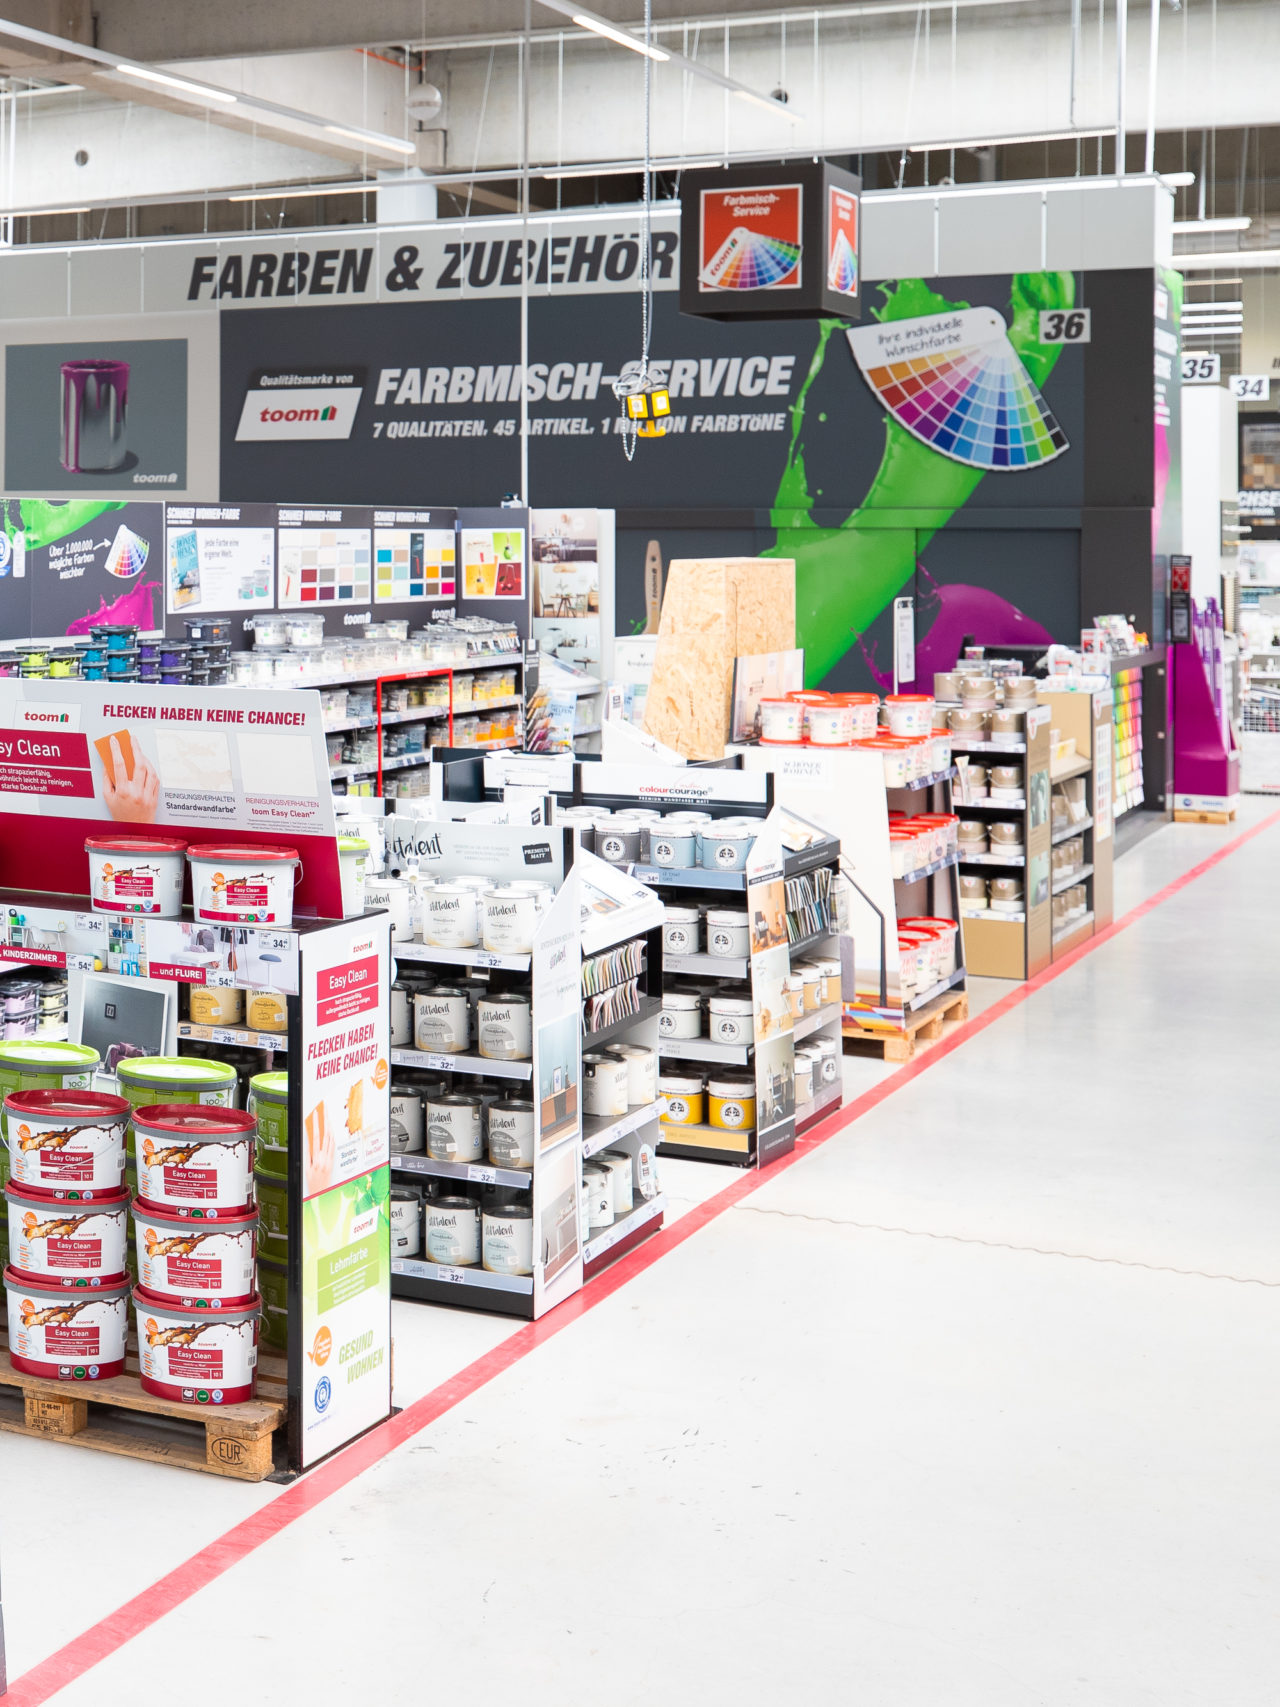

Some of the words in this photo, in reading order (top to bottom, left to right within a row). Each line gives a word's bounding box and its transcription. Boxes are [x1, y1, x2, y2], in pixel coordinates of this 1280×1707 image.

[723, 193, 779, 207] Farbmisch-
[733, 204, 770, 218] Service
[187, 247, 374, 300] FARBEN
[385, 245, 423, 292] &
[436, 231, 679, 290] ZUBEHÖR
[1043, 312, 1086, 341] 36
[1182, 359, 1215, 379] 35
[260, 374, 332, 387] Qualitätsmarke
[335, 375, 354, 385] von
[1237, 379, 1264, 397] 34
[259, 407, 322, 423] toom
[373, 423, 384, 438] 7
[494, 419, 516, 436] 45
[601, 418, 611, 434] 1
[690, 413, 786, 432] FARBTÖNE
[133, 473, 168, 484] toom
[344, 613, 365, 626] toom
[24, 711, 59, 722] toom
[103, 704, 157, 720] FLECKEN
[160, 707, 203, 722] HABEN
[206, 709, 245, 723] KEINE
[248, 711, 306, 726] CHANCE!
[17, 739, 61, 757] Clean
[23, 776, 39, 785] leicht
[1, 783, 19, 791] starke
[20, 784, 48, 793] Deckkraft
[639, 785, 708, 797] colourcourage
[165, 792, 235, 803] REINIGUNGSVERHALTEN
[245, 797, 319, 808] REINIGUNGSVERHALTEN
[252, 808, 270, 816] toom
[271, 808, 288, 818] Easy
[3, 949, 58, 963] KINDERZIMMER
[160, 968, 174, 977] und
[175, 969, 203, 979] FLURE!
[329, 975, 347, 989] Easy
[348, 968, 368, 983] Clean
[308, 1033, 346, 1060] FLECKEN
[347, 1023, 375, 1047] HABEN
[316, 1056, 342, 1080] KEINE
[343, 1043, 378, 1071] CHANCE!
[49, 1153, 64, 1164] Easy
[66, 1153, 83, 1163] Clean
[172, 1171, 187, 1180] Easy
[188, 1170, 206, 1179] Clean
[57, 1240, 72, 1250] Easy
[73, 1241, 91, 1250] Clean
[176, 1260, 192, 1270] Easy
[193, 1261, 211, 1270] Clean
[330, 1246, 368, 1275] Lehmfarbe
[55, 1329, 70, 1338] Easy
[71, 1329, 89, 1337] Clean
[339, 1330, 373, 1365] GESUND
[347, 1347, 384, 1385] WOHNEN
[219, 1440, 242, 1461] EUR
